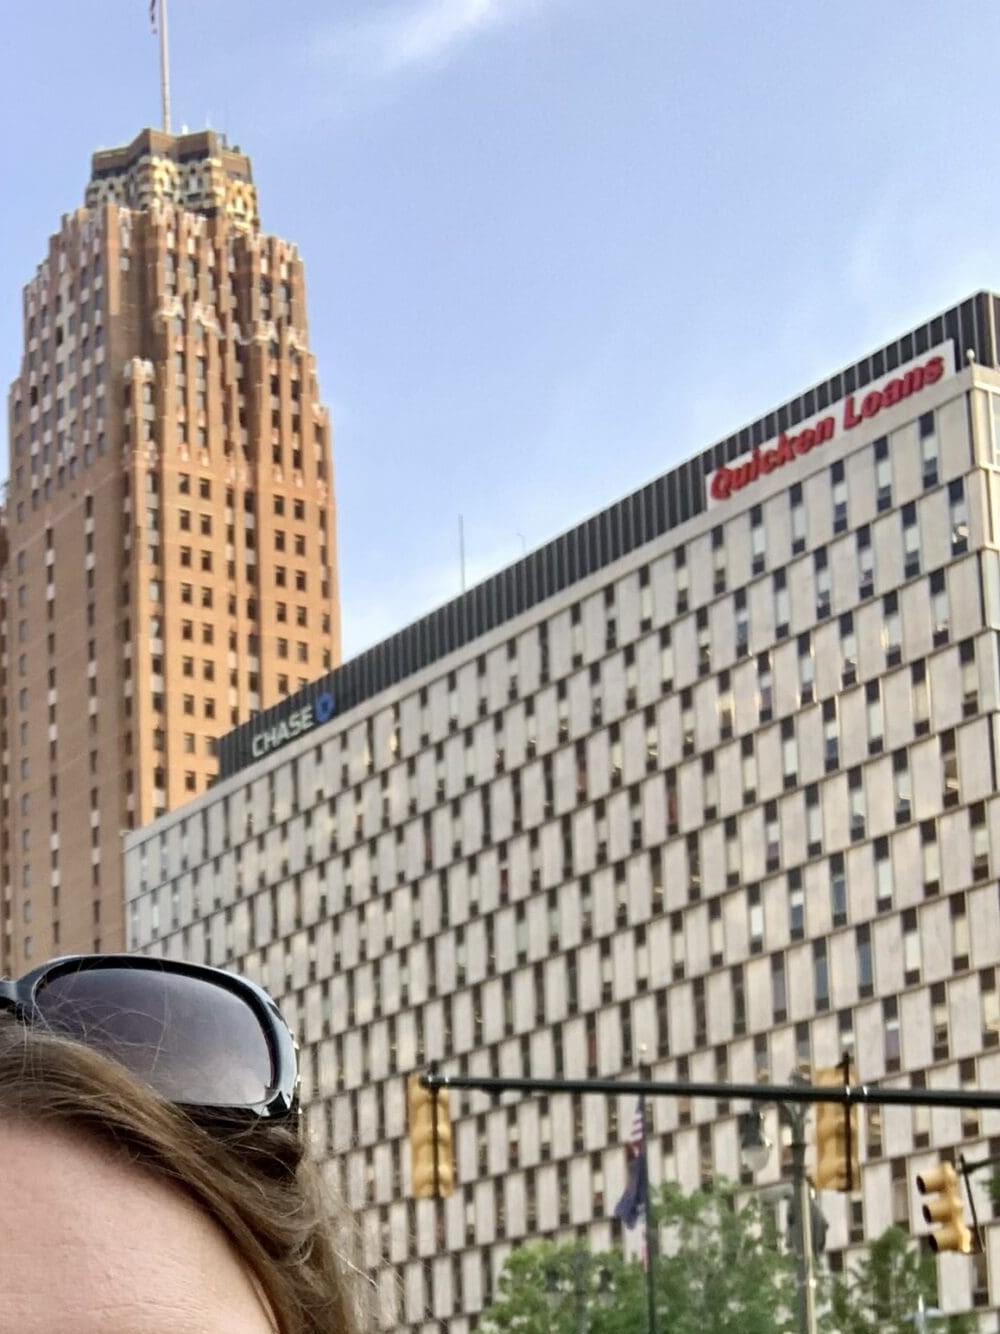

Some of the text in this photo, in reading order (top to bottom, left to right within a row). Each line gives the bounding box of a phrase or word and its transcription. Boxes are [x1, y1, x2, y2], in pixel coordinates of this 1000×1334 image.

[710, 356, 945, 500] Quicken Loans
[252, 704, 314, 758] CHASE
